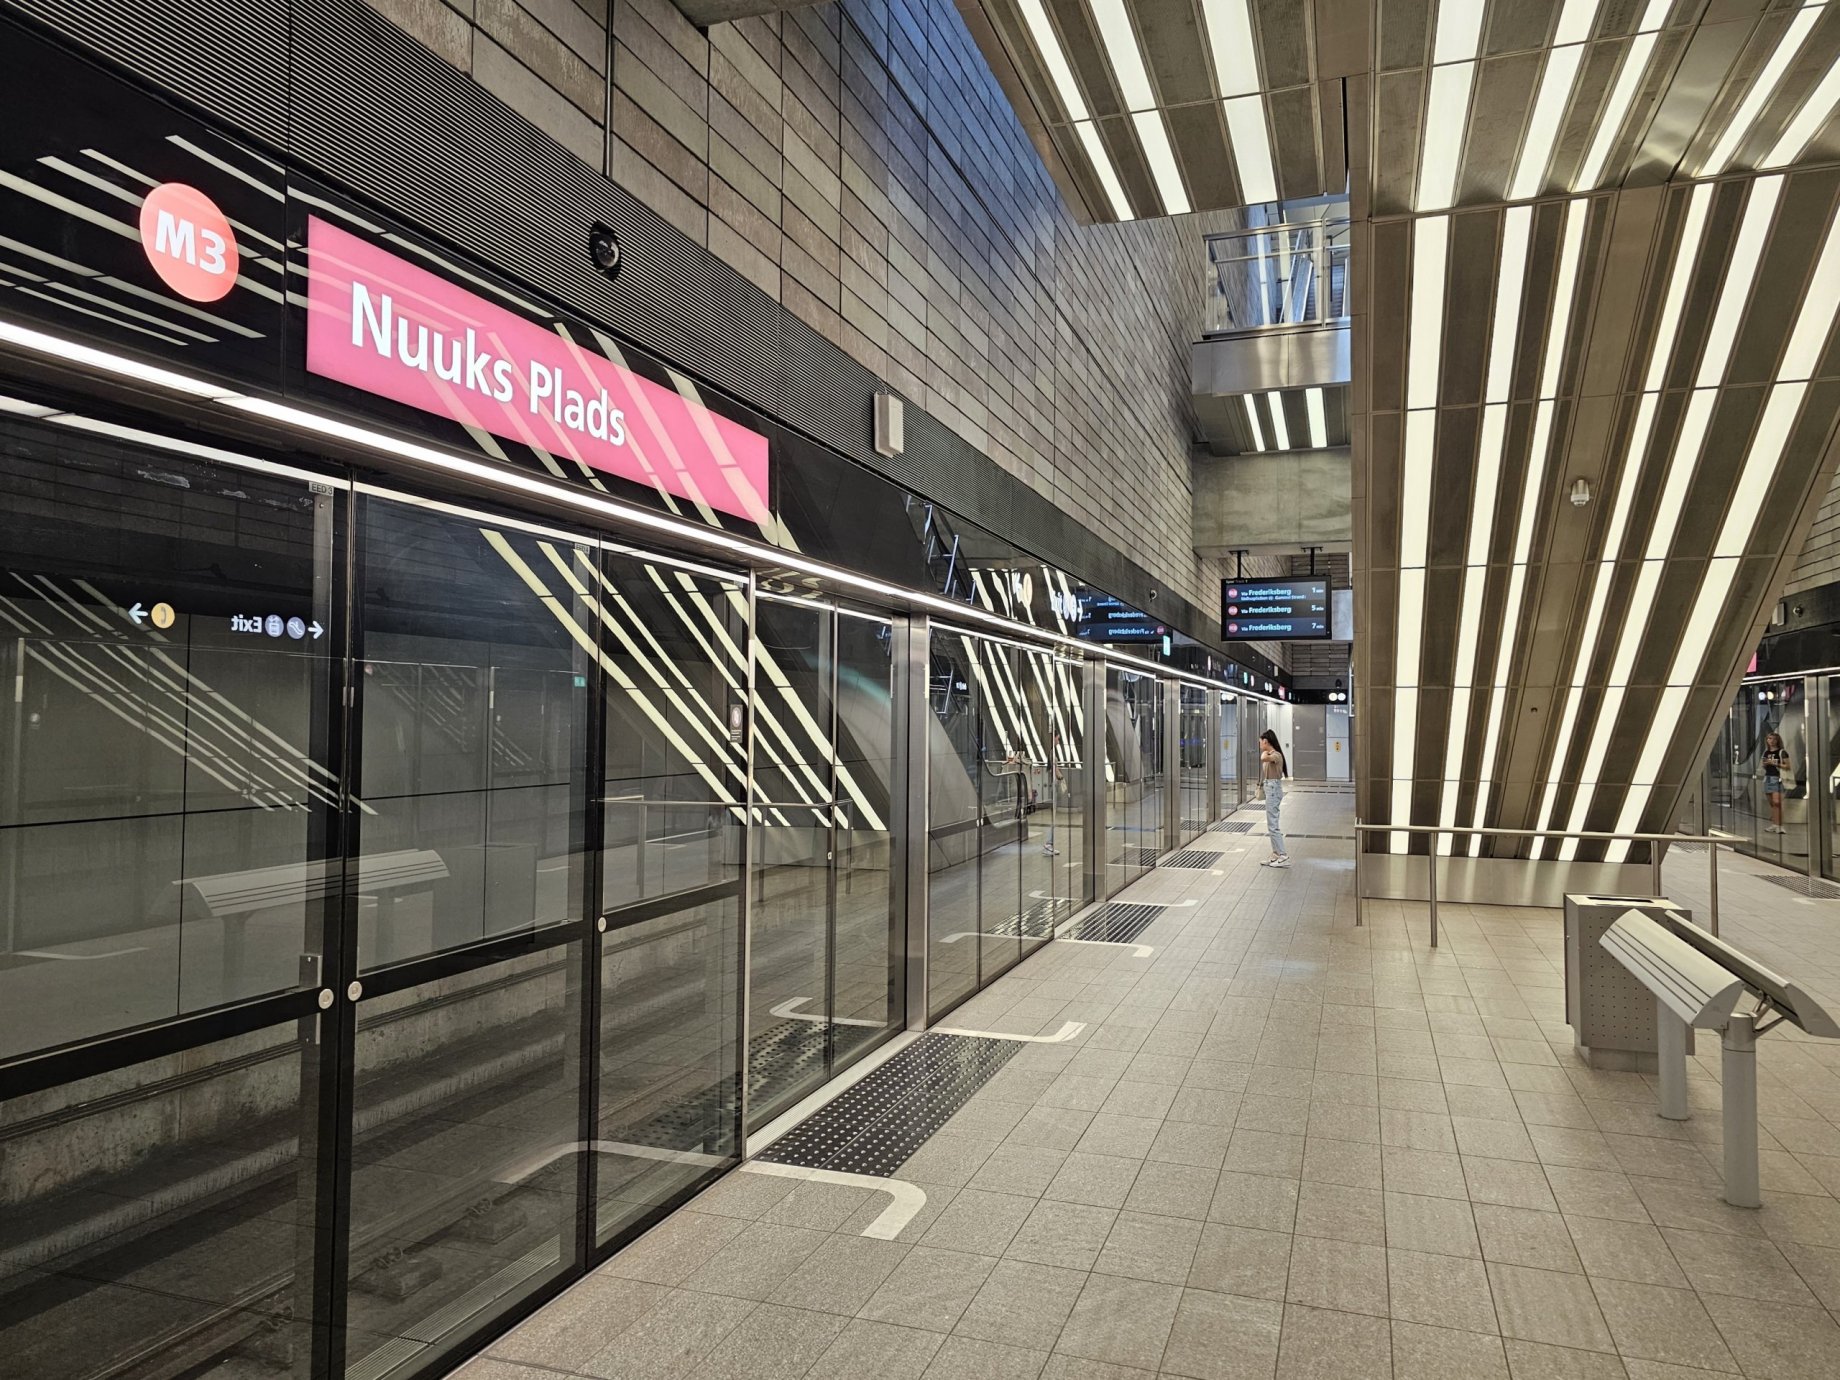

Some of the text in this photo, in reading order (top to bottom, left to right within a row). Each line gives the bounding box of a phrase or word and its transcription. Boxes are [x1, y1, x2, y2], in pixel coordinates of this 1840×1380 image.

[155, 208, 226, 275] M3
[352, 281, 626, 446] Nuuks Plads
[312, 484, 333, 495] EED 3
